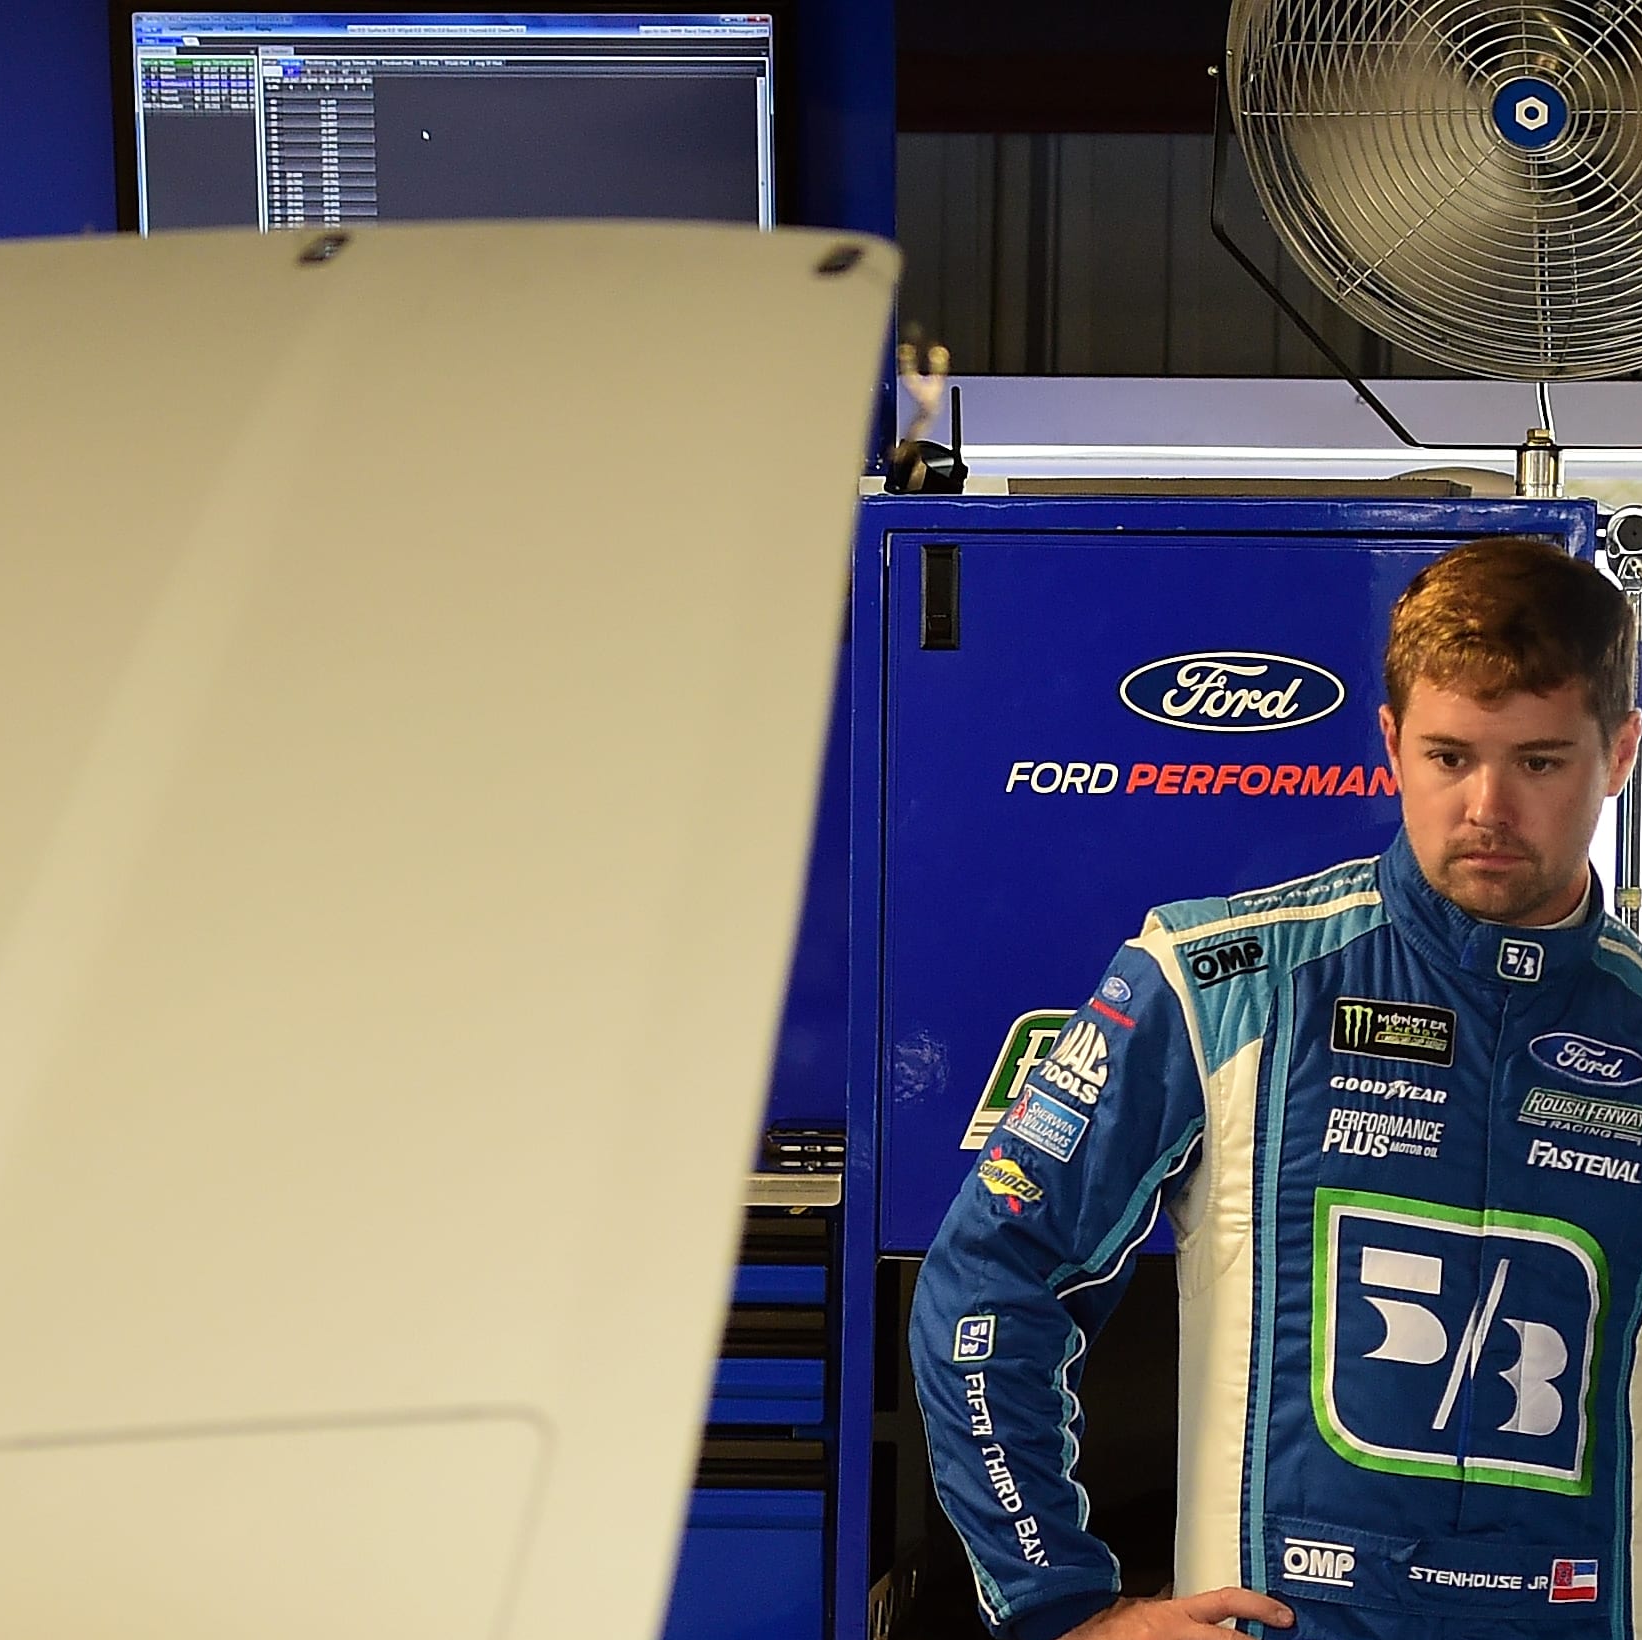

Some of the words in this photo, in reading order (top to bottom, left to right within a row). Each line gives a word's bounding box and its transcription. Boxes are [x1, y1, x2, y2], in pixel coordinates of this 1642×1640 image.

[1161, 660, 1301, 720] Ford
[1005, 761, 1119, 794] FORD
[1125, 763, 1400, 797] PERFORMAN
[1191, 941, 1264, 981] OMP
[1050, 1019, 1108, 1088] MAC
[1556, 1041, 1623, 1080] Ford
[1039, 1060, 1100, 1106] TOOLS
[1028, 1101, 1077, 1137] SHERWIN
[1527, 1091, 1589, 1120] ROUSH
[1021, 1111, 1072, 1148] WILLIAMS
[1322, 1128, 1391, 1159] PLUS
[1390, 1140, 1423, 1156] MOTOR
[1423, 1146, 1438, 1158] OIL
[1328, 1108, 1445, 1143] PERFORMANCE
[1548, 1119, 1613, 1138] RACING
[1526, 1138, 1642, 1185] FASTENAL
[978, 1161, 1044, 1200] SUNOCO
[964, 1371, 993, 1437] FIFTH
[981, 1443, 1023, 1513] THIRD
[1014, 1514, 1050, 1567] BAN
[1283, 1546, 1355, 1579] OMP
[1408, 1565, 1523, 1590] STENHOUSE
[1526, 1575, 1549, 1590] JR
